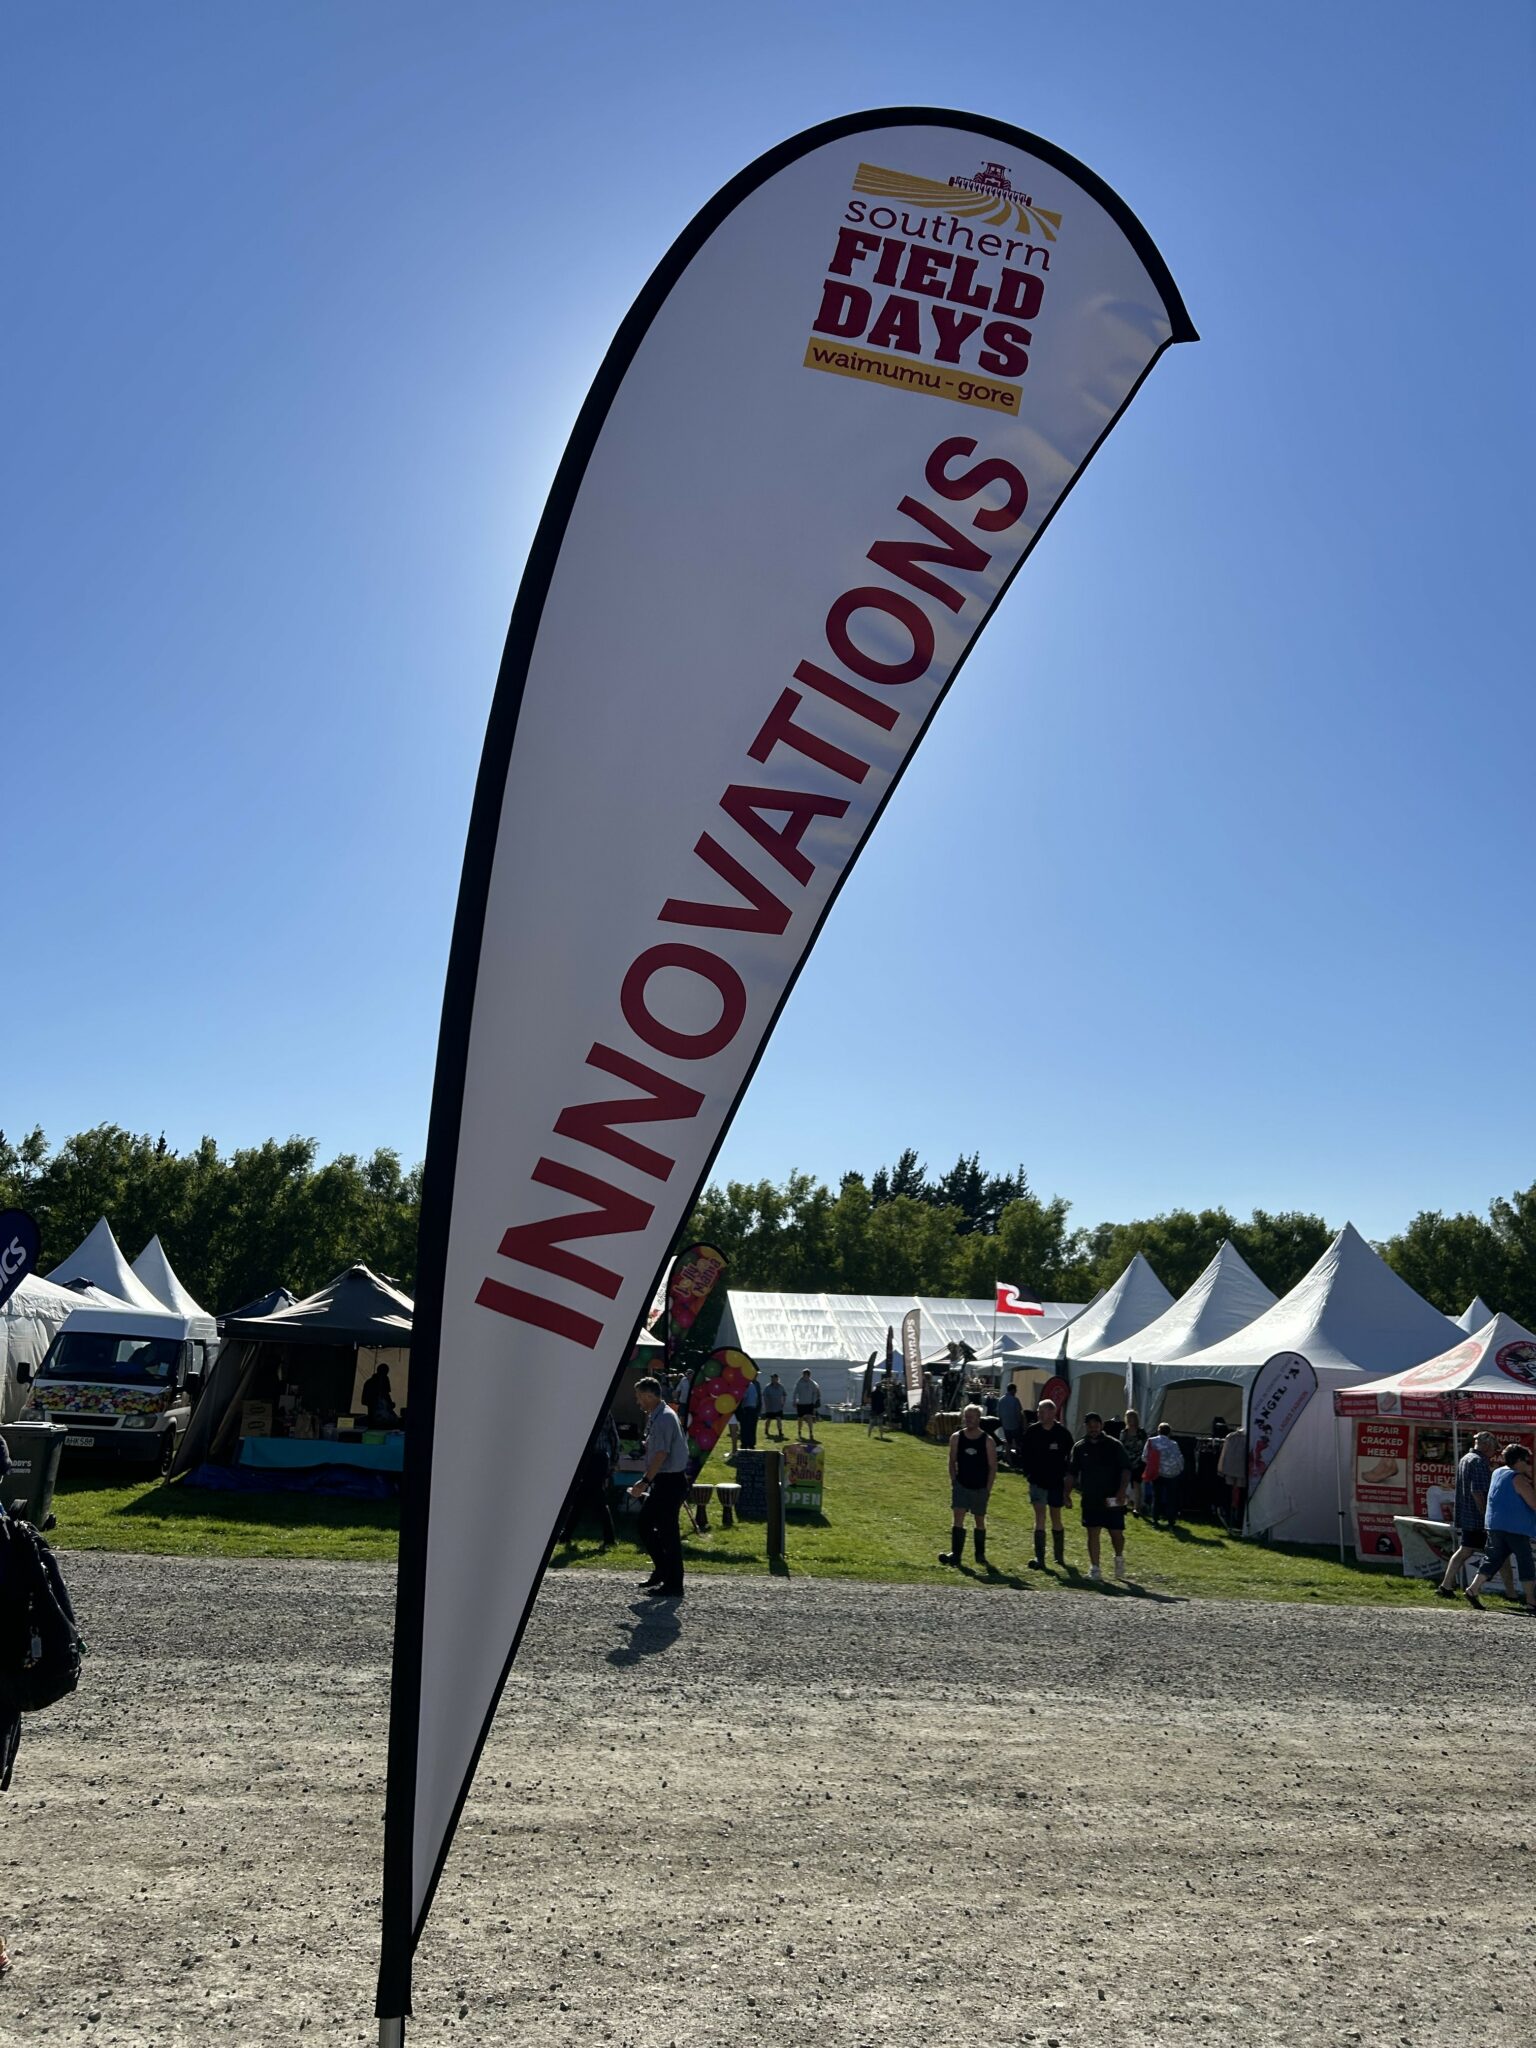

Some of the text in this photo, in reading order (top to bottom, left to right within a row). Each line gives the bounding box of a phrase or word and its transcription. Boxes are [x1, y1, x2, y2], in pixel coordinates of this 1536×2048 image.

[844, 199, 1051, 272] southern
[827, 226, 1045, 320] FIELD
[812, 278, 1033, 378] DAYS
[475, 435, 1029, 1350] INNOVATIONS
[0, 1235, 27, 1291] ICS
[906, 1318, 918, 1360] WRAPS
[1360, 1436, 1404, 1446] CRACKED
[1366, 1425, 1399, 1435] REPAIR
[1367, 1447, 1399, 1457] HEELS!
[784, 1491, 821, 1506] OPEN
